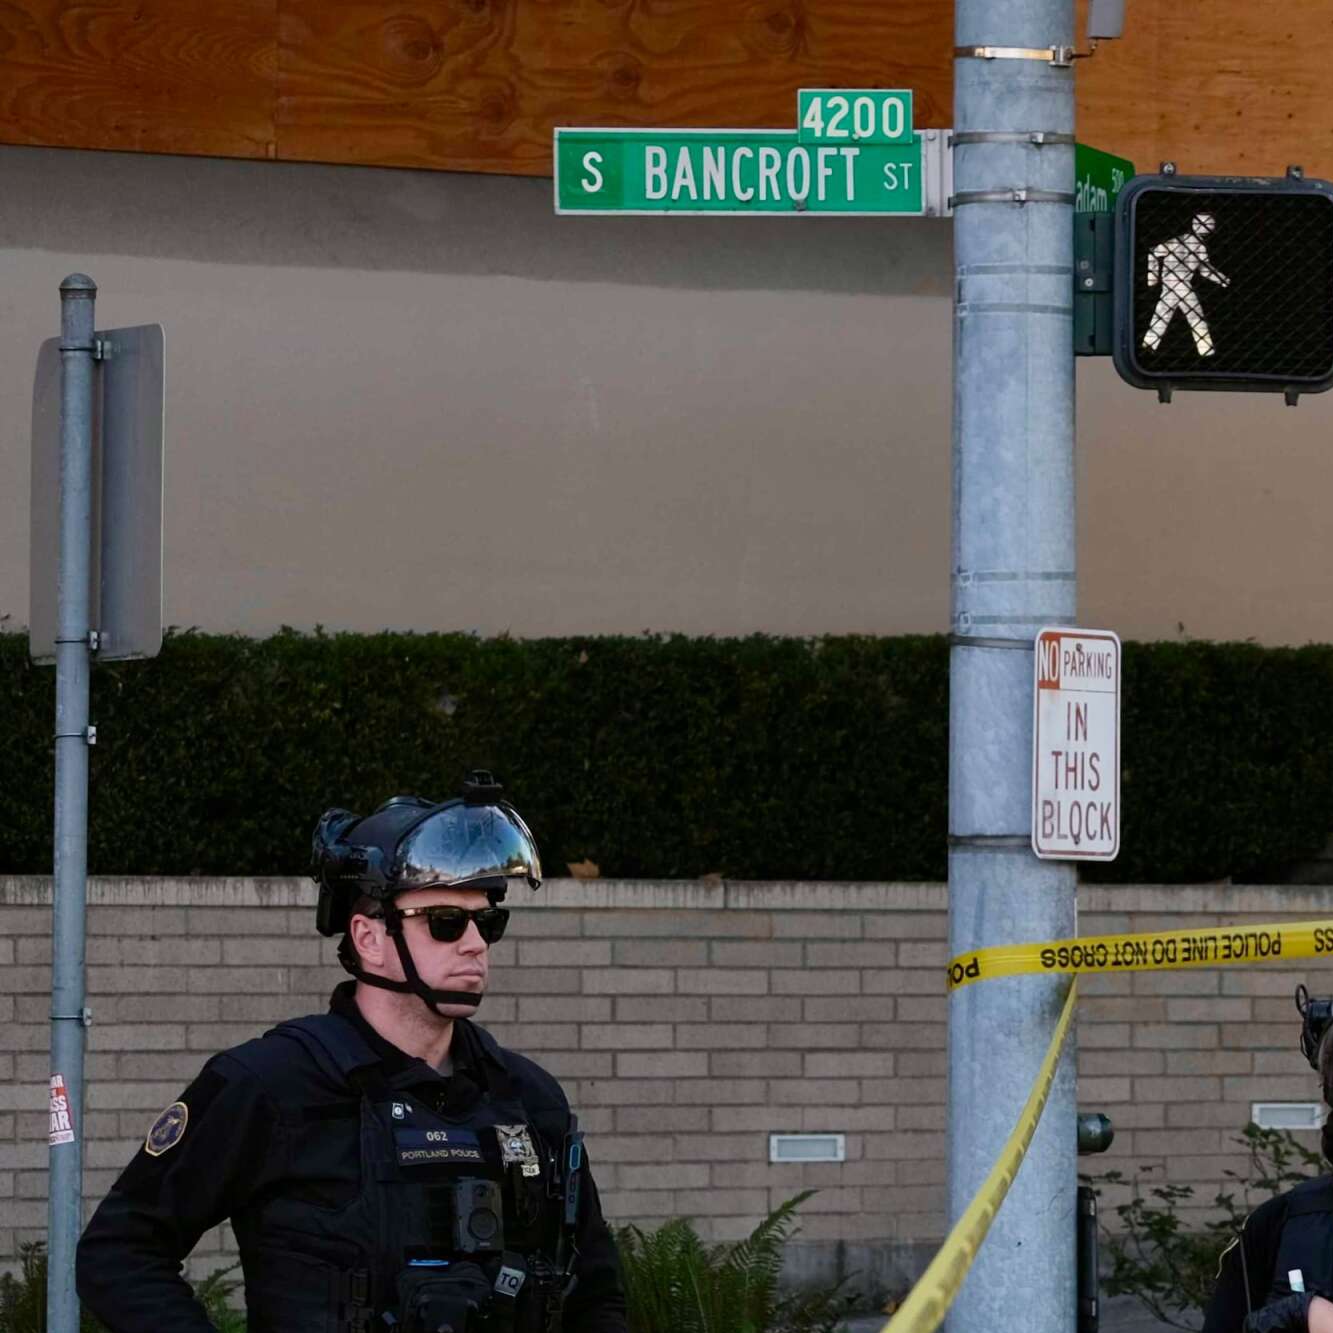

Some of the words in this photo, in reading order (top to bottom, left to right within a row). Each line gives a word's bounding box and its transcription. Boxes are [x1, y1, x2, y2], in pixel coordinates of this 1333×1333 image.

[803, 96, 905, 139] 4200
[580, 151, 604, 193] S
[644, 145, 861, 202] BANCROFT
[883, 163, 913, 190] ST
[1039, 640, 1060, 681] NO
[1063, 649, 1112, 679] PARKING
[1066, 702, 1088, 741] IN
[1051, 750, 1100, 791] THIS
[1041, 799, 1112, 841] BLOCK
[1040, 943, 1108, 968] CROSS
[1111, 941, 1147, 966] NOT
[1152, 939, 1176, 964] DO
[1181, 936, 1217, 962] LINE
[1221, 930, 1281, 959] POLICE
[426, 1131, 448, 1141] 062
[401, 1149, 449, 1160] PORTLAND
[450, 1149, 481, 1159] POLICE
[502, 1272, 519, 1288] TQ
